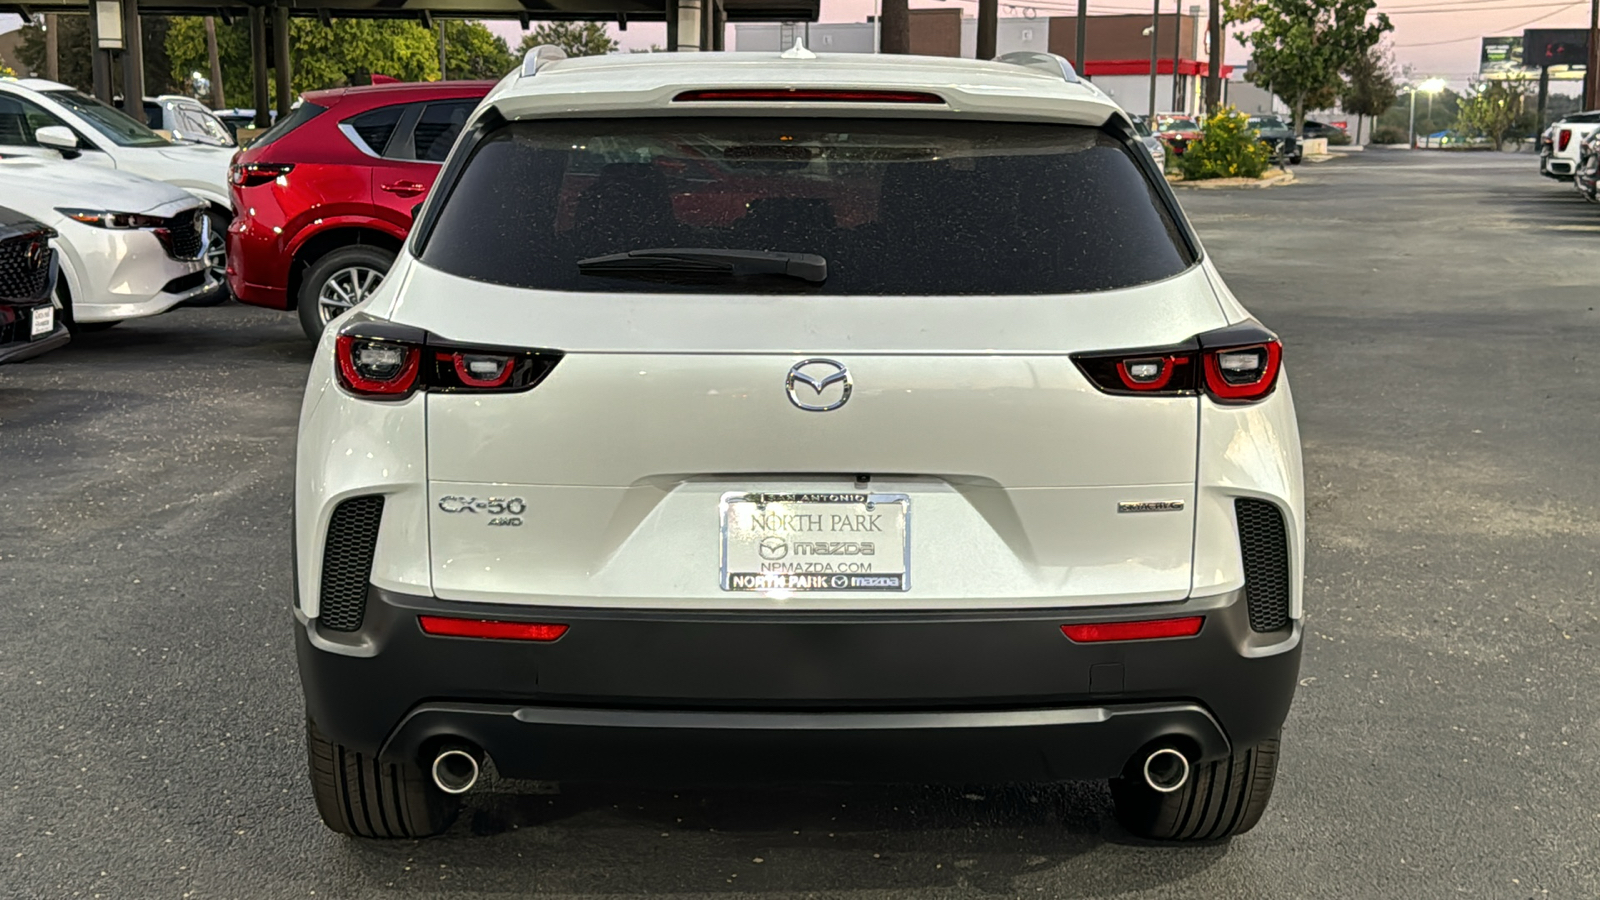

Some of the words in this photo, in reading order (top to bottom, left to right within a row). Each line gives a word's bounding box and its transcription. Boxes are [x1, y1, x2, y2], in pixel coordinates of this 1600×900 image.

[768, 494, 795, 502] SAN
[801, 494, 865, 502] ANTONIO
[438, 495, 527, 515] CX-50
[487, 517, 523, 527] AWD
[751, 514, 823, 532] NORTH
[830, 514, 883, 532] PARK
[794, 542, 875, 556] mazda
[761, 562, 872, 573] NPMAZDA.COM
[733, 575, 788, 588] NORTH
[790, 576, 828, 588] PARK
[851, 577, 899, 587] mazda
